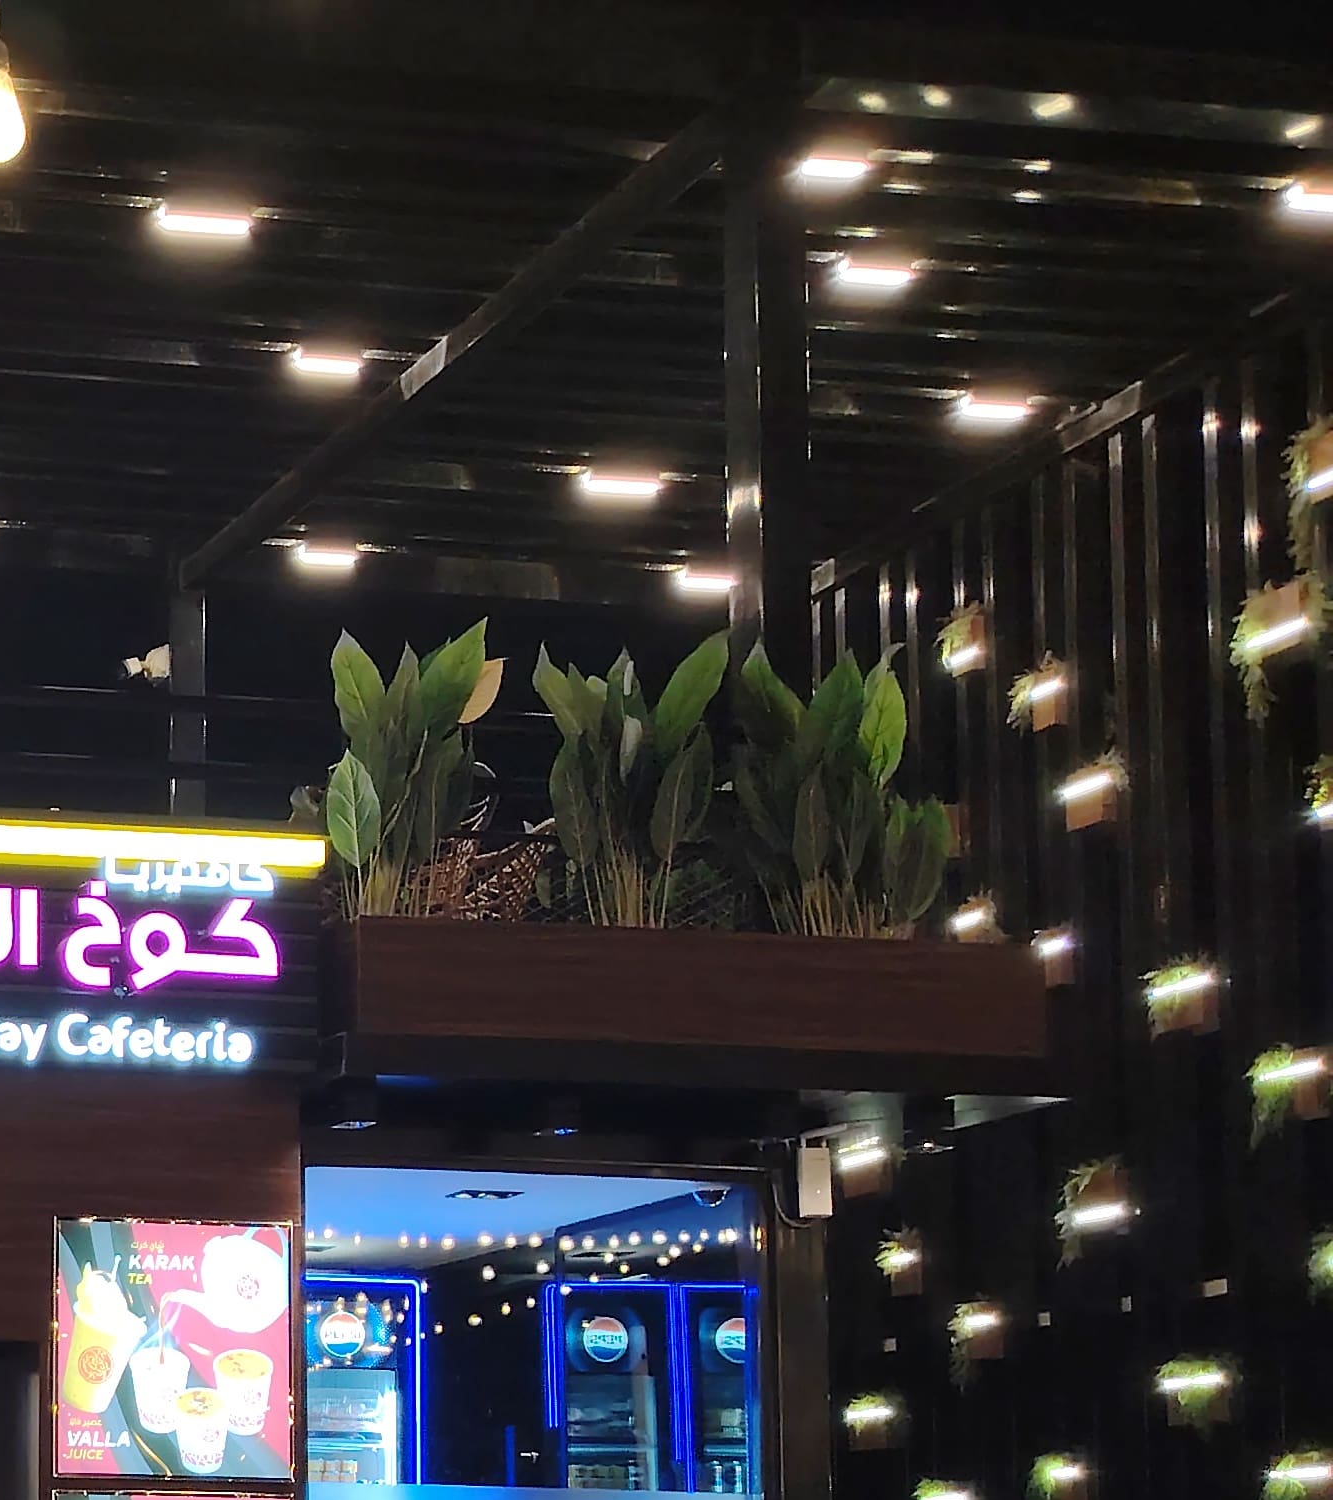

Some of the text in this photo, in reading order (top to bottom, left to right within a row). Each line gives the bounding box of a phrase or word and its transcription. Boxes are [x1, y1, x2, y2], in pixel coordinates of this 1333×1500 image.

[63, 879, 279, 990] كوخ
[56, 1012, 253, 1064] Cafeteria
[128, 1254, 195, 1271] KARAK
[128, 1272, 153, 1285] TEA
[65, 1448, 105, 1460] JUICE
